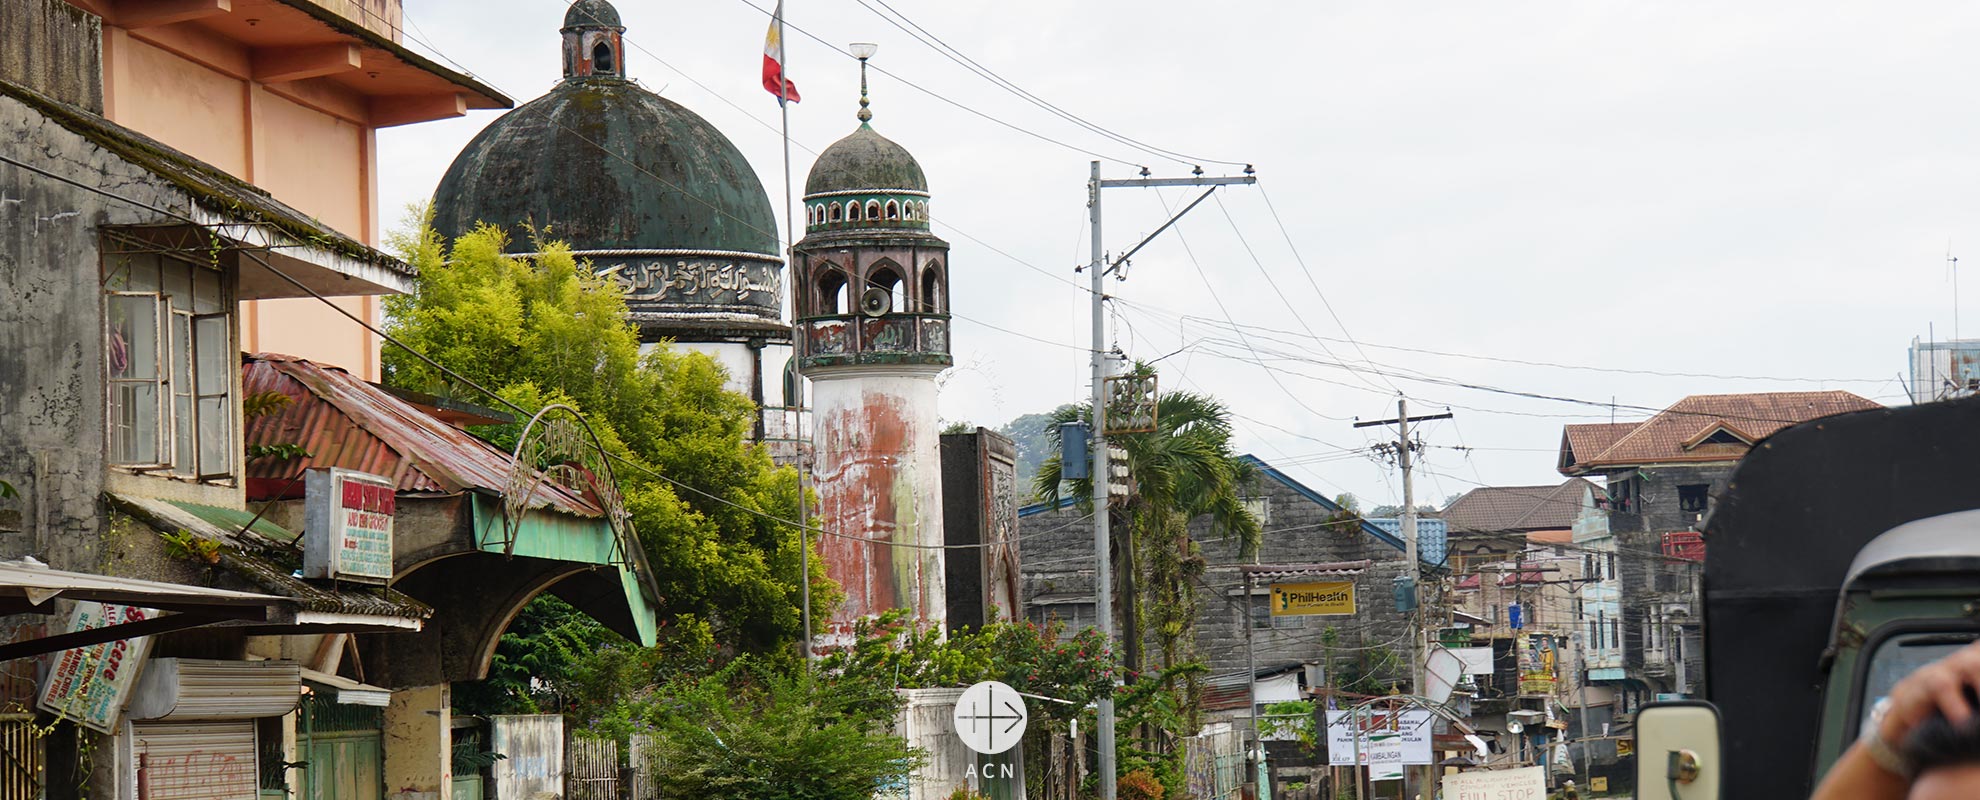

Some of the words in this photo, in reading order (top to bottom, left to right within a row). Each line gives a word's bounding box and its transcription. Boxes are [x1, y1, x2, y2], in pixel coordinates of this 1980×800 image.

[1290, 592, 1348, 603] PhilHealth
[57, 650, 74, 678] MANGO
[68, 647, 84, 676] MANGO
[46, 679, 62, 704] PUREE
[59, 677, 72, 699] CHIPS
[1497, 788, 1534, 800] STOP
